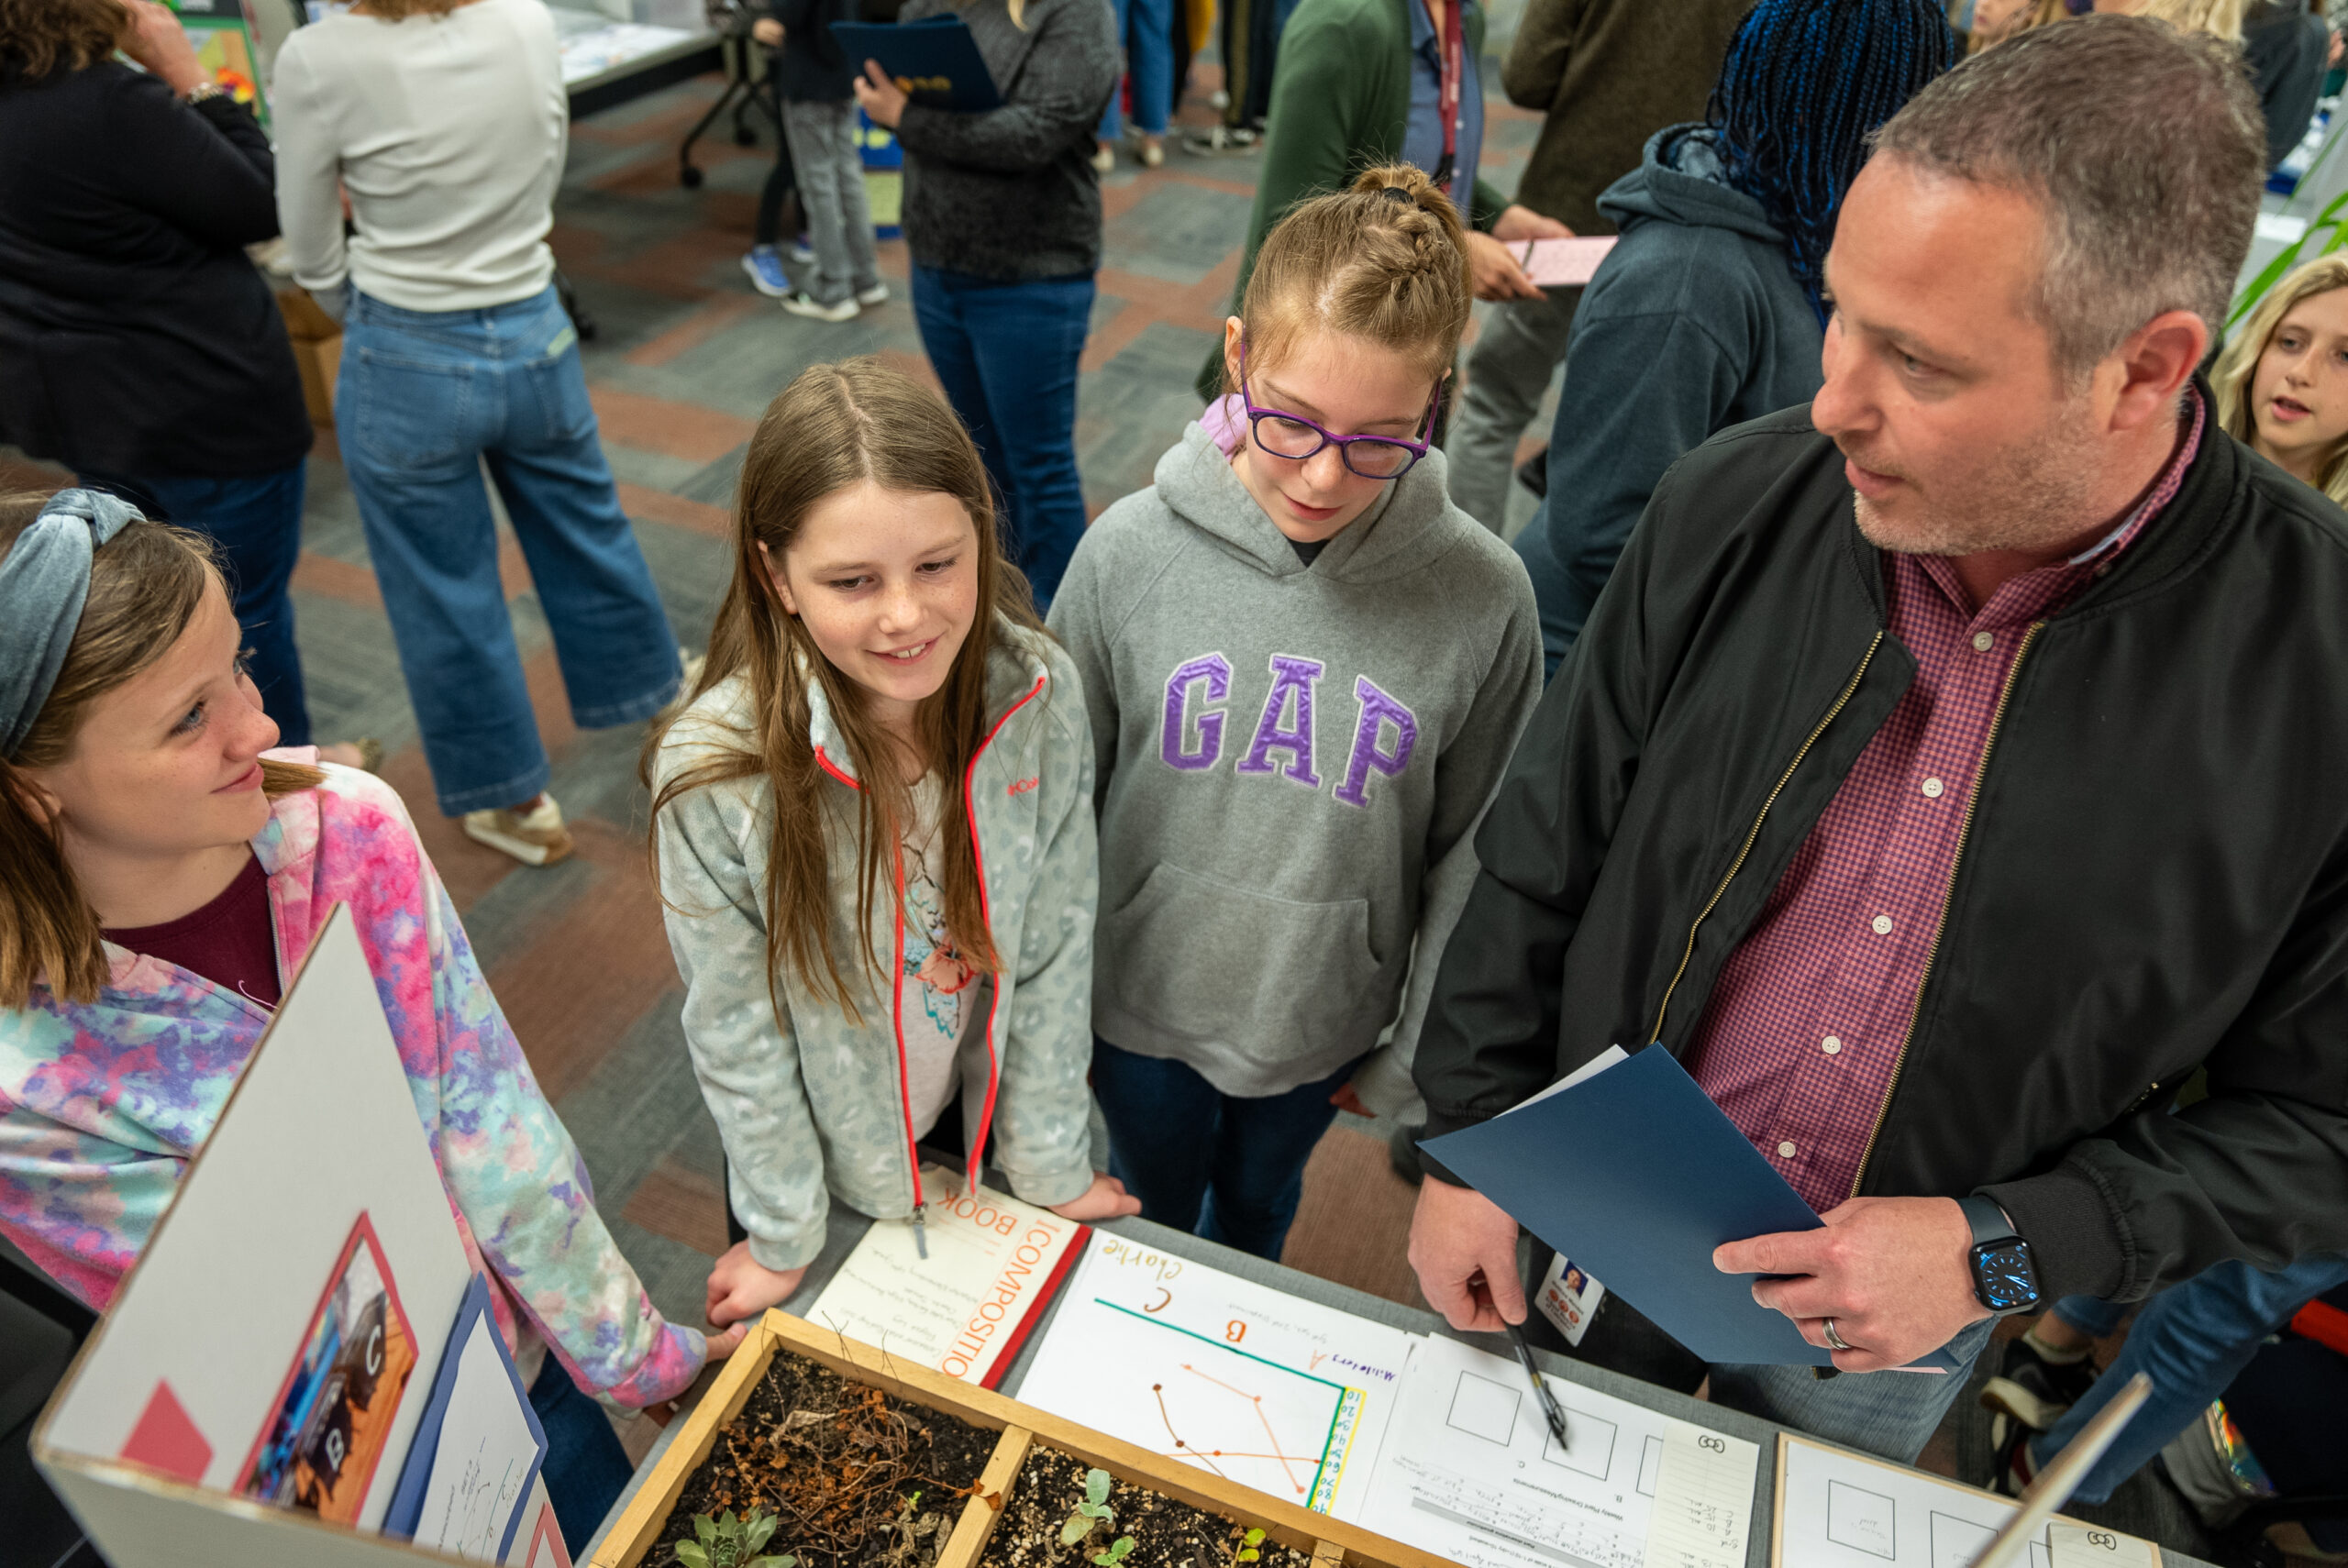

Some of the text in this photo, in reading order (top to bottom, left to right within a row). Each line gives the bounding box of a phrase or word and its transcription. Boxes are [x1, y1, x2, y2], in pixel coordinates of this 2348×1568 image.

[1158, 651, 1418, 809] GAP
[936, 1187, 1018, 1236] BOOK
[1102, 1239, 1182, 1281] Charlie
[942, 1229, 1052, 1378] COMPOSITIO
[1144, 1286, 1171, 1313] C
[1225, 1320, 1246, 1342] B
[365, 1324, 382, 1375] C
[1309, 1350, 1327, 1371] A
[1346, 1391, 1361, 1402] 10
[1341, 1405, 1356, 1418] 20
[1335, 1419, 1351, 1431] 30
[1332, 1433, 1346, 1446] 40
[326, 1428, 345, 1471] B
[1325, 1461, 1340, 1474] 60
[1320, 1476, 1335, 1487] 70
[1317, 1488, 1333, 1500] 80
[1584, 1503, 1600, 1515] Plant
[1601, 1508, 1623, 1521] Weekly
